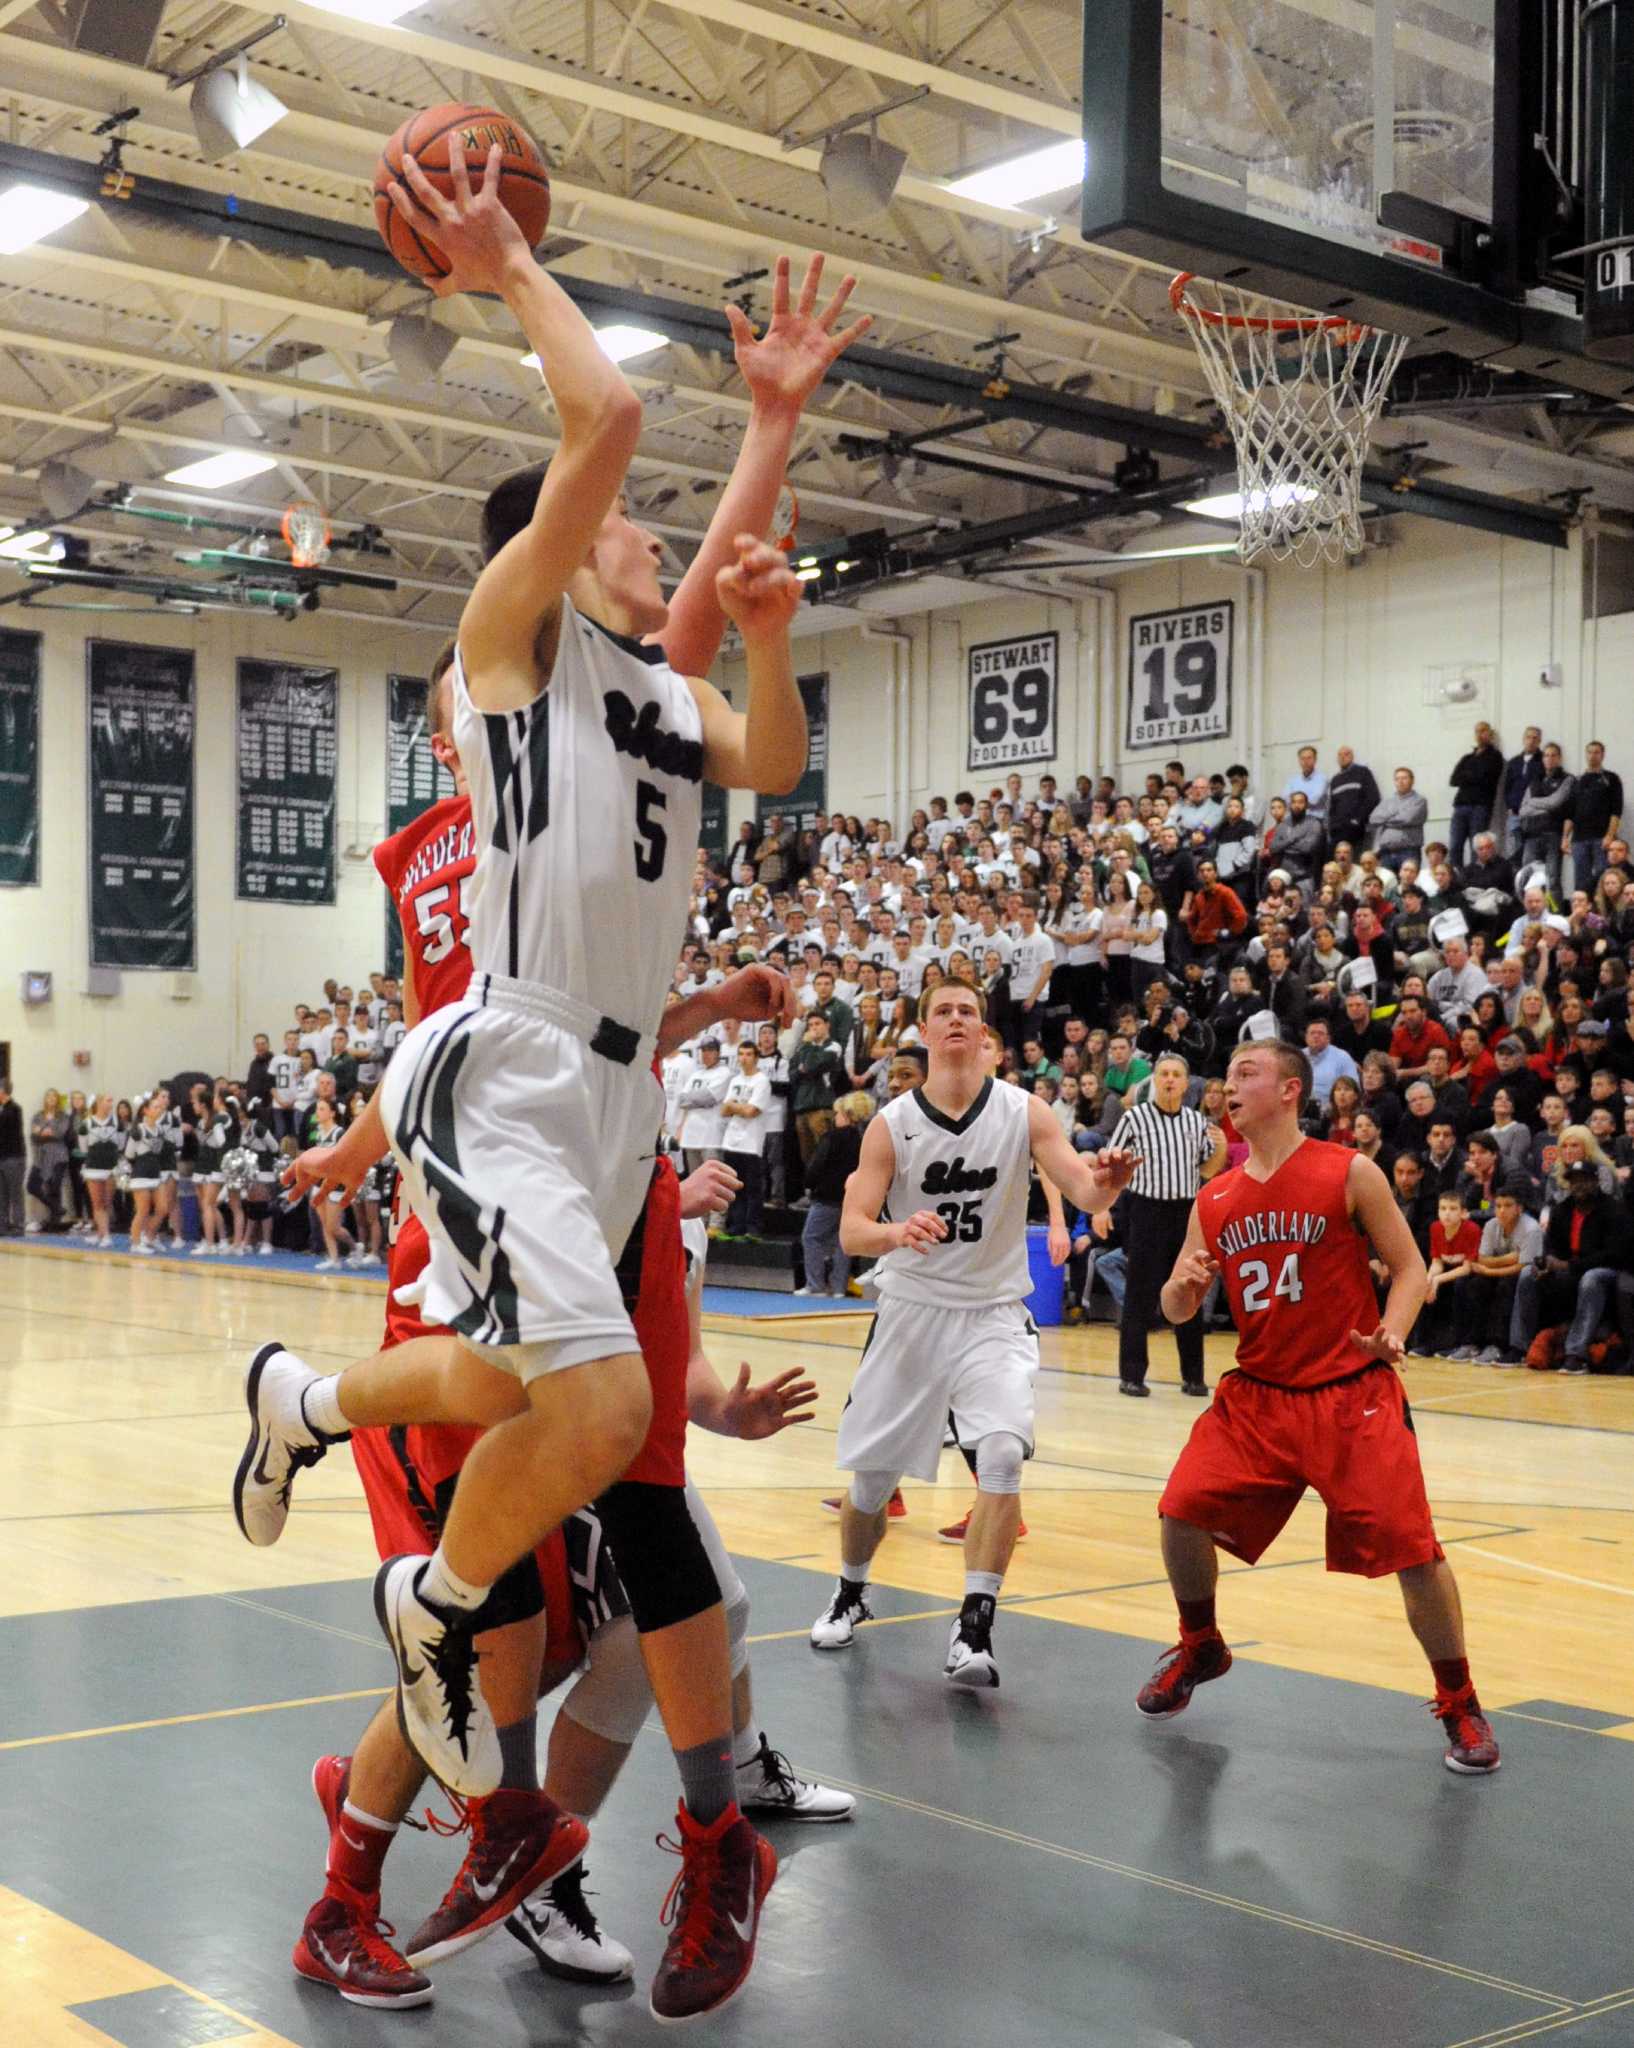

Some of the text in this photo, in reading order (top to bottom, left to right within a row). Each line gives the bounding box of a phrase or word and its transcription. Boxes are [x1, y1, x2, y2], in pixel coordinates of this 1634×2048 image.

[1138, 611, 1225, 647] RIVERS
[973, 641, 1052, 675] STEWART
[1143, 639, 1217, 722] 19
[973, 667, 1050, 744] 69
[1135, 715, 1223, 740] SOFTBALL
[973, 738, 1050, 762] FOOTBALL
[633, 780, 667, 883] 5
[936, 1199, 983, 1244] 35
[1239, 1252, 1303, 1312] 24
